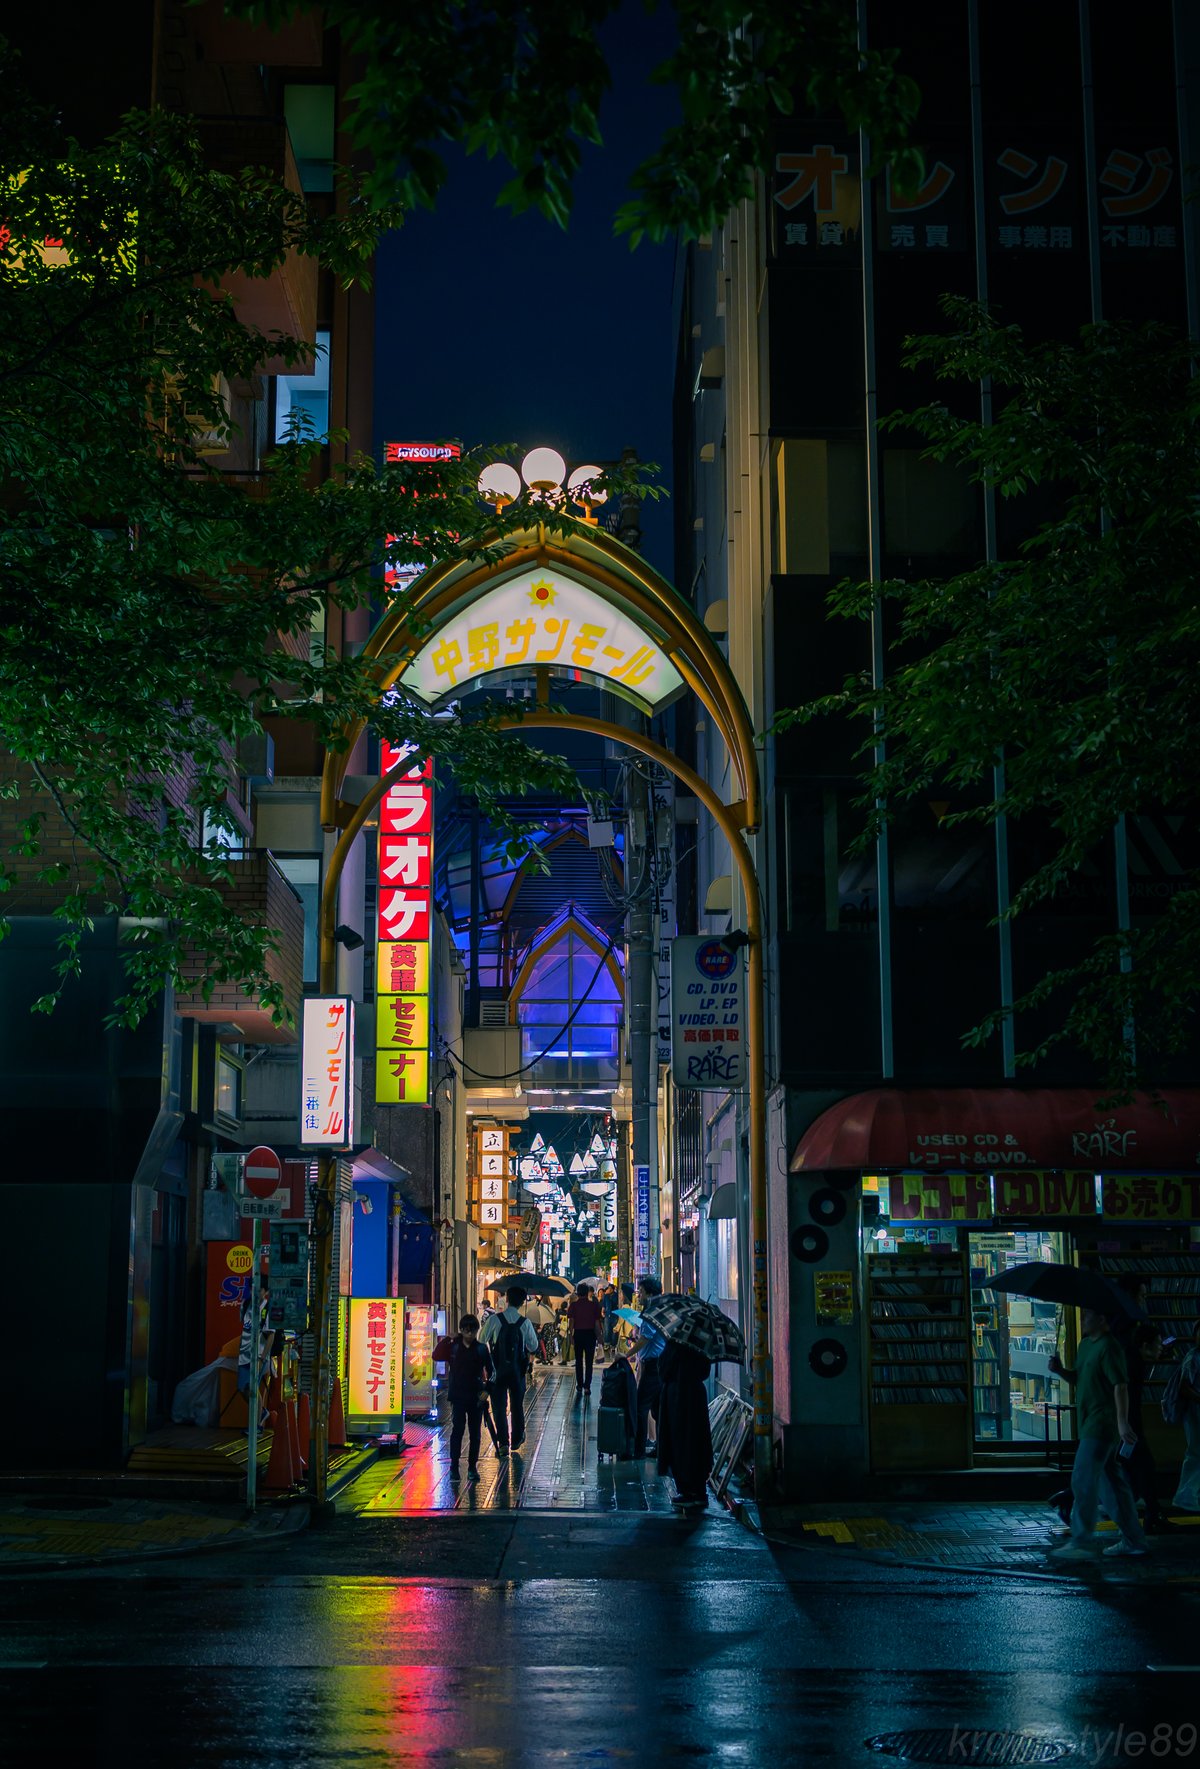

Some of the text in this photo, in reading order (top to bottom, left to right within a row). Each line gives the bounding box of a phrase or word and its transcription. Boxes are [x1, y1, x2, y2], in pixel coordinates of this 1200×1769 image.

[773, 144, 1174, 217] オレンジ
[785, 222, 1177, 248] 賃貸 売買 事業用 不動産
[431, 617, 657, 686] 中野サンモール
[711, 983, 738, 995] DVD
[722, 998, 738, 1010] EP
[389, 944, 417, 1100] 英語セミナー
[723, 1014, 738, 1025] LD
[684, 1028, 739, 1042] 高価買取
[322, 1004, 345, 1135] サンモール
[687, 1055, 740, 1081] RARE
[917, 1134, 1019, 1146] USED CD &
[889, 1176, 988, 1219] レコード
[230, 1256, 251, 1268] ¥100
[366, 1302, 388, 1411] 英語セミナー
